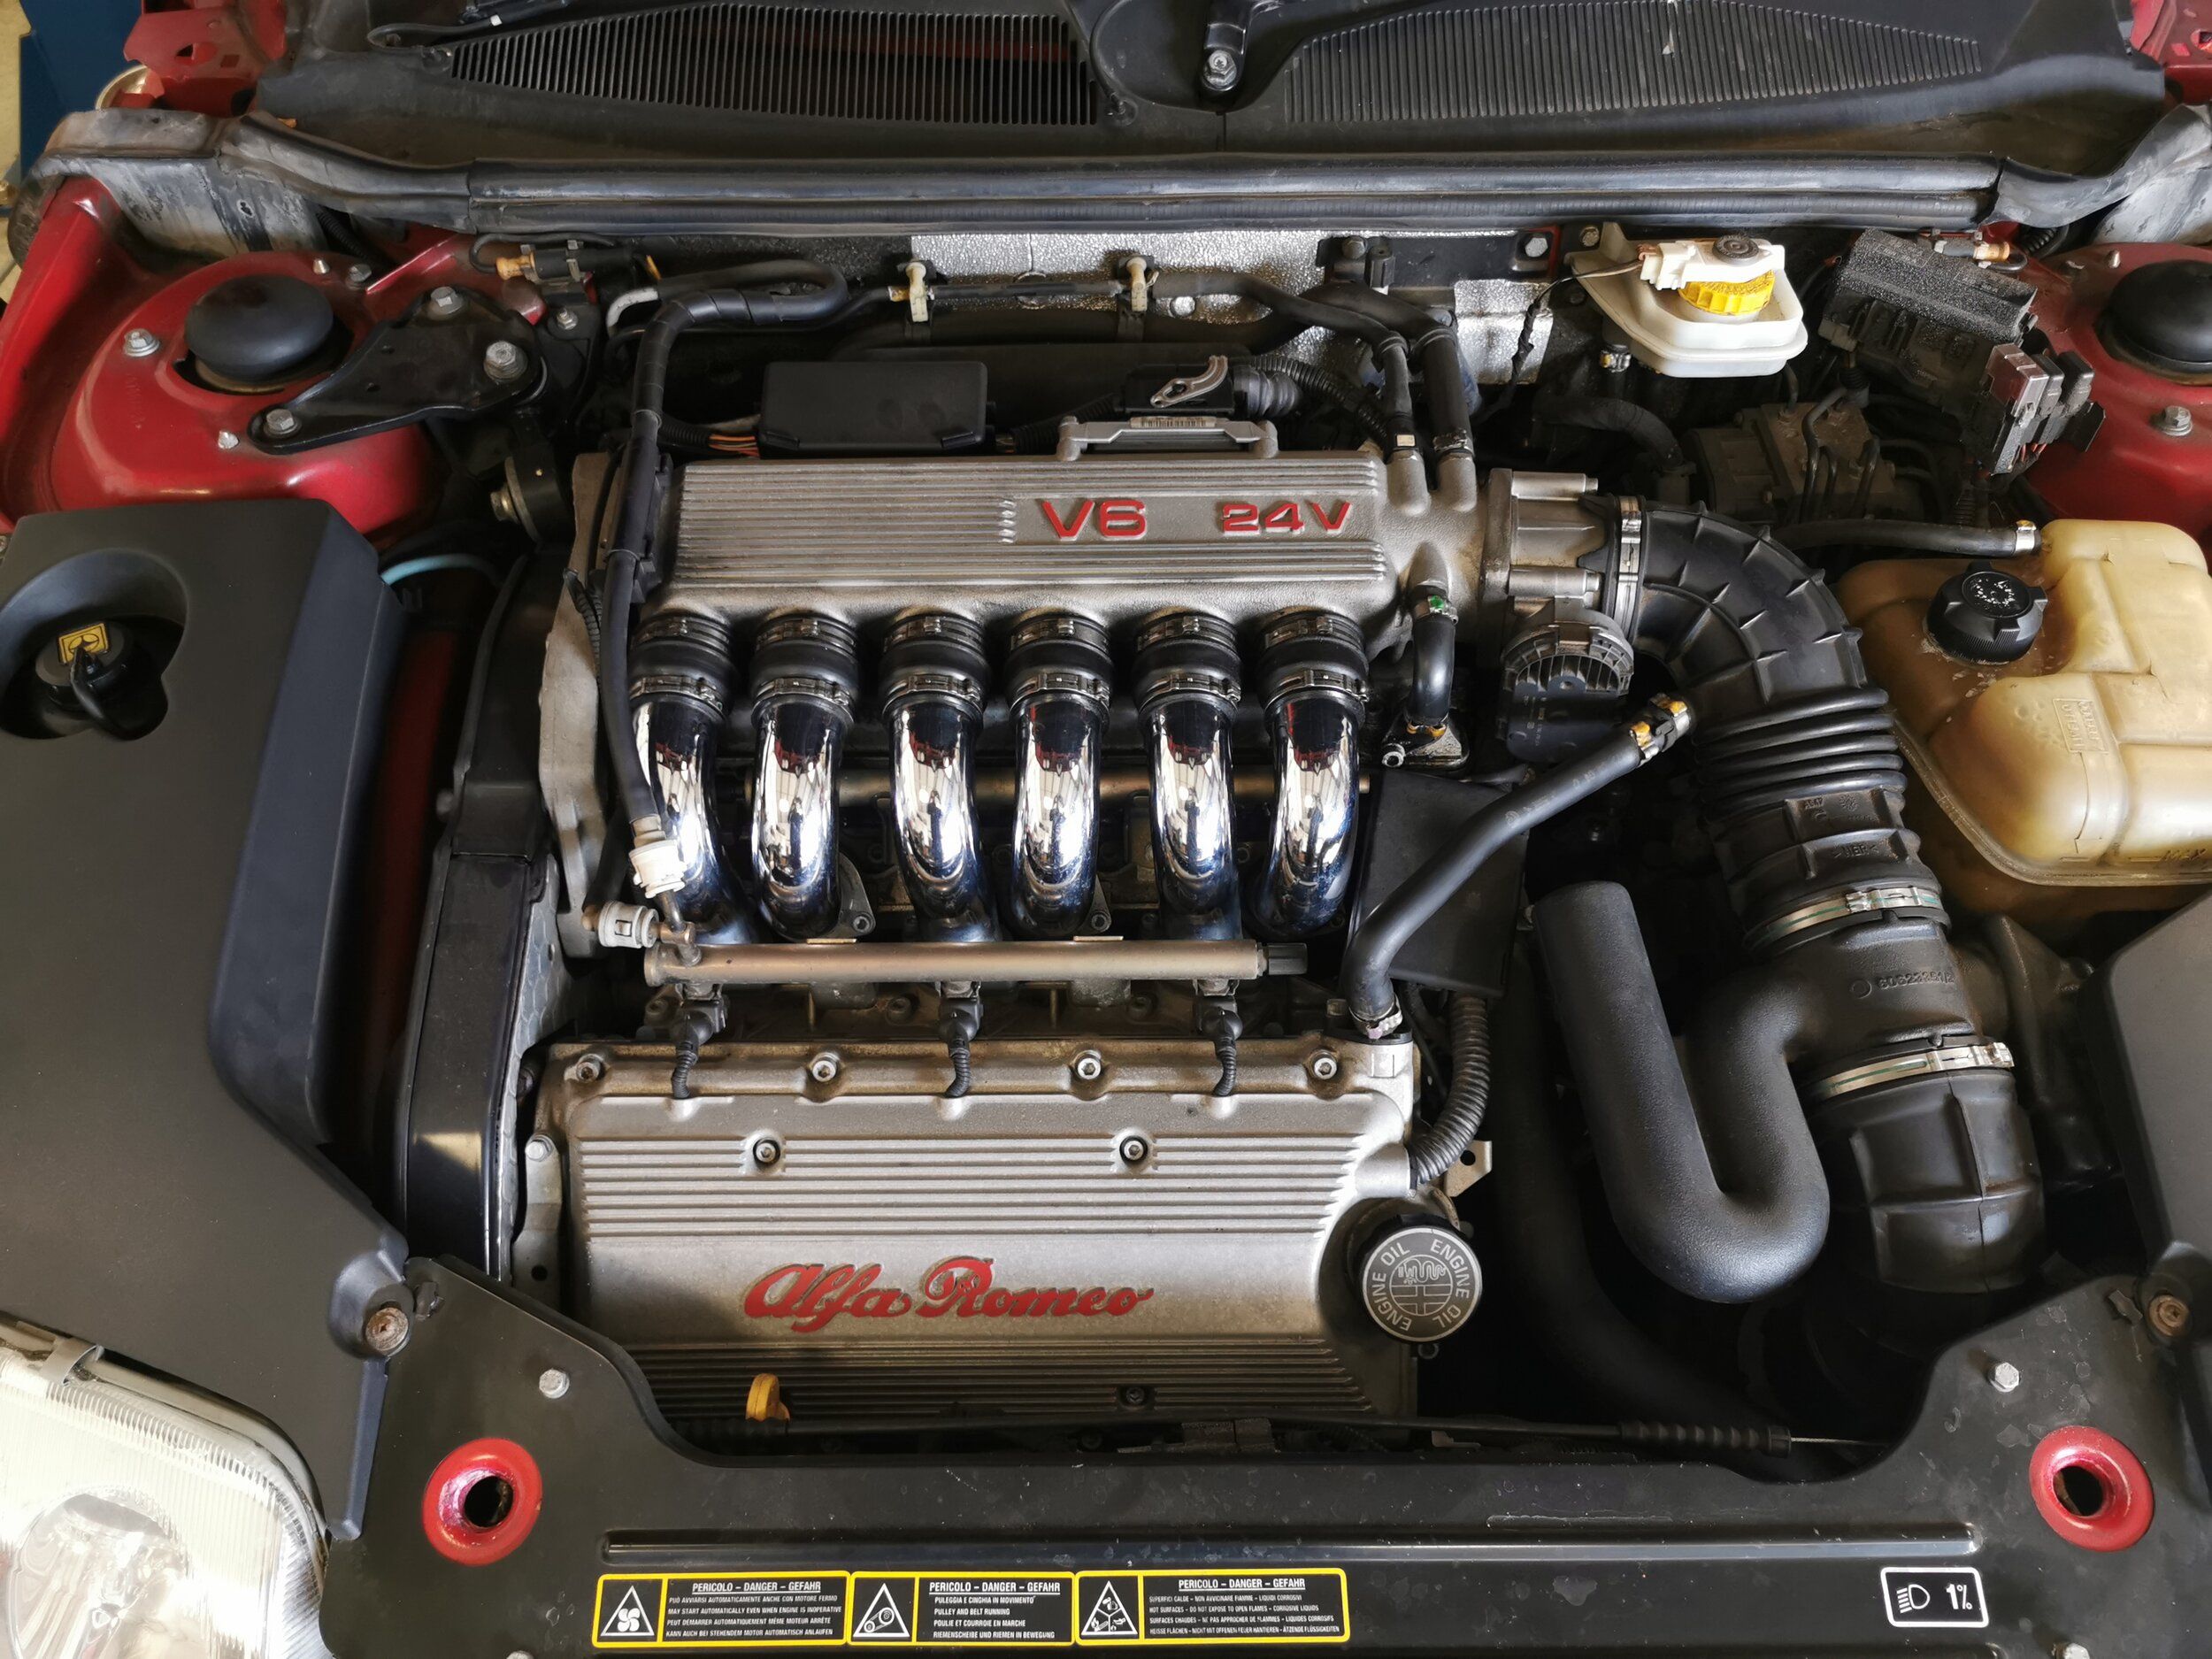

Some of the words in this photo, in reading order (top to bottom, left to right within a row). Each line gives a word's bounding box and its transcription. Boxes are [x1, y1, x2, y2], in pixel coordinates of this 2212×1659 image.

[1040, 499, 1147, 540] V6
[1221, 501, 1351, 535] 24V
[1380, 1242, 1410, 1266] OIL
[1430, 1239, 1470, 1299] ENGINE
[743, 1263, 912, 1333] Alfa
[915, 1255, 1155, 1317] Romeo
[1371, 1271, 1413, 1332] ENGINE
[1432, 1304, 1462, 1328] OIL
[692, 1583, 733, 1592] PERICOLO
[743, 1582, 778, 1591] DANGER
[788, 1581, 821, 1591] GEFAHR
[929, 1582, 972, 1592] PERICOLO
[982, 1582, 1017, 1592] DANGER
[1027, 1582, 1060, 1592] GEFAHR
[1179, 1579, 1218, 1588] PERICOLO
[1229, 1578, 1262, 1588] DANGER
[1273, 1578, 1305, 1587] GEFAHR
[1946, 1583, 1973, 1610] 1%
